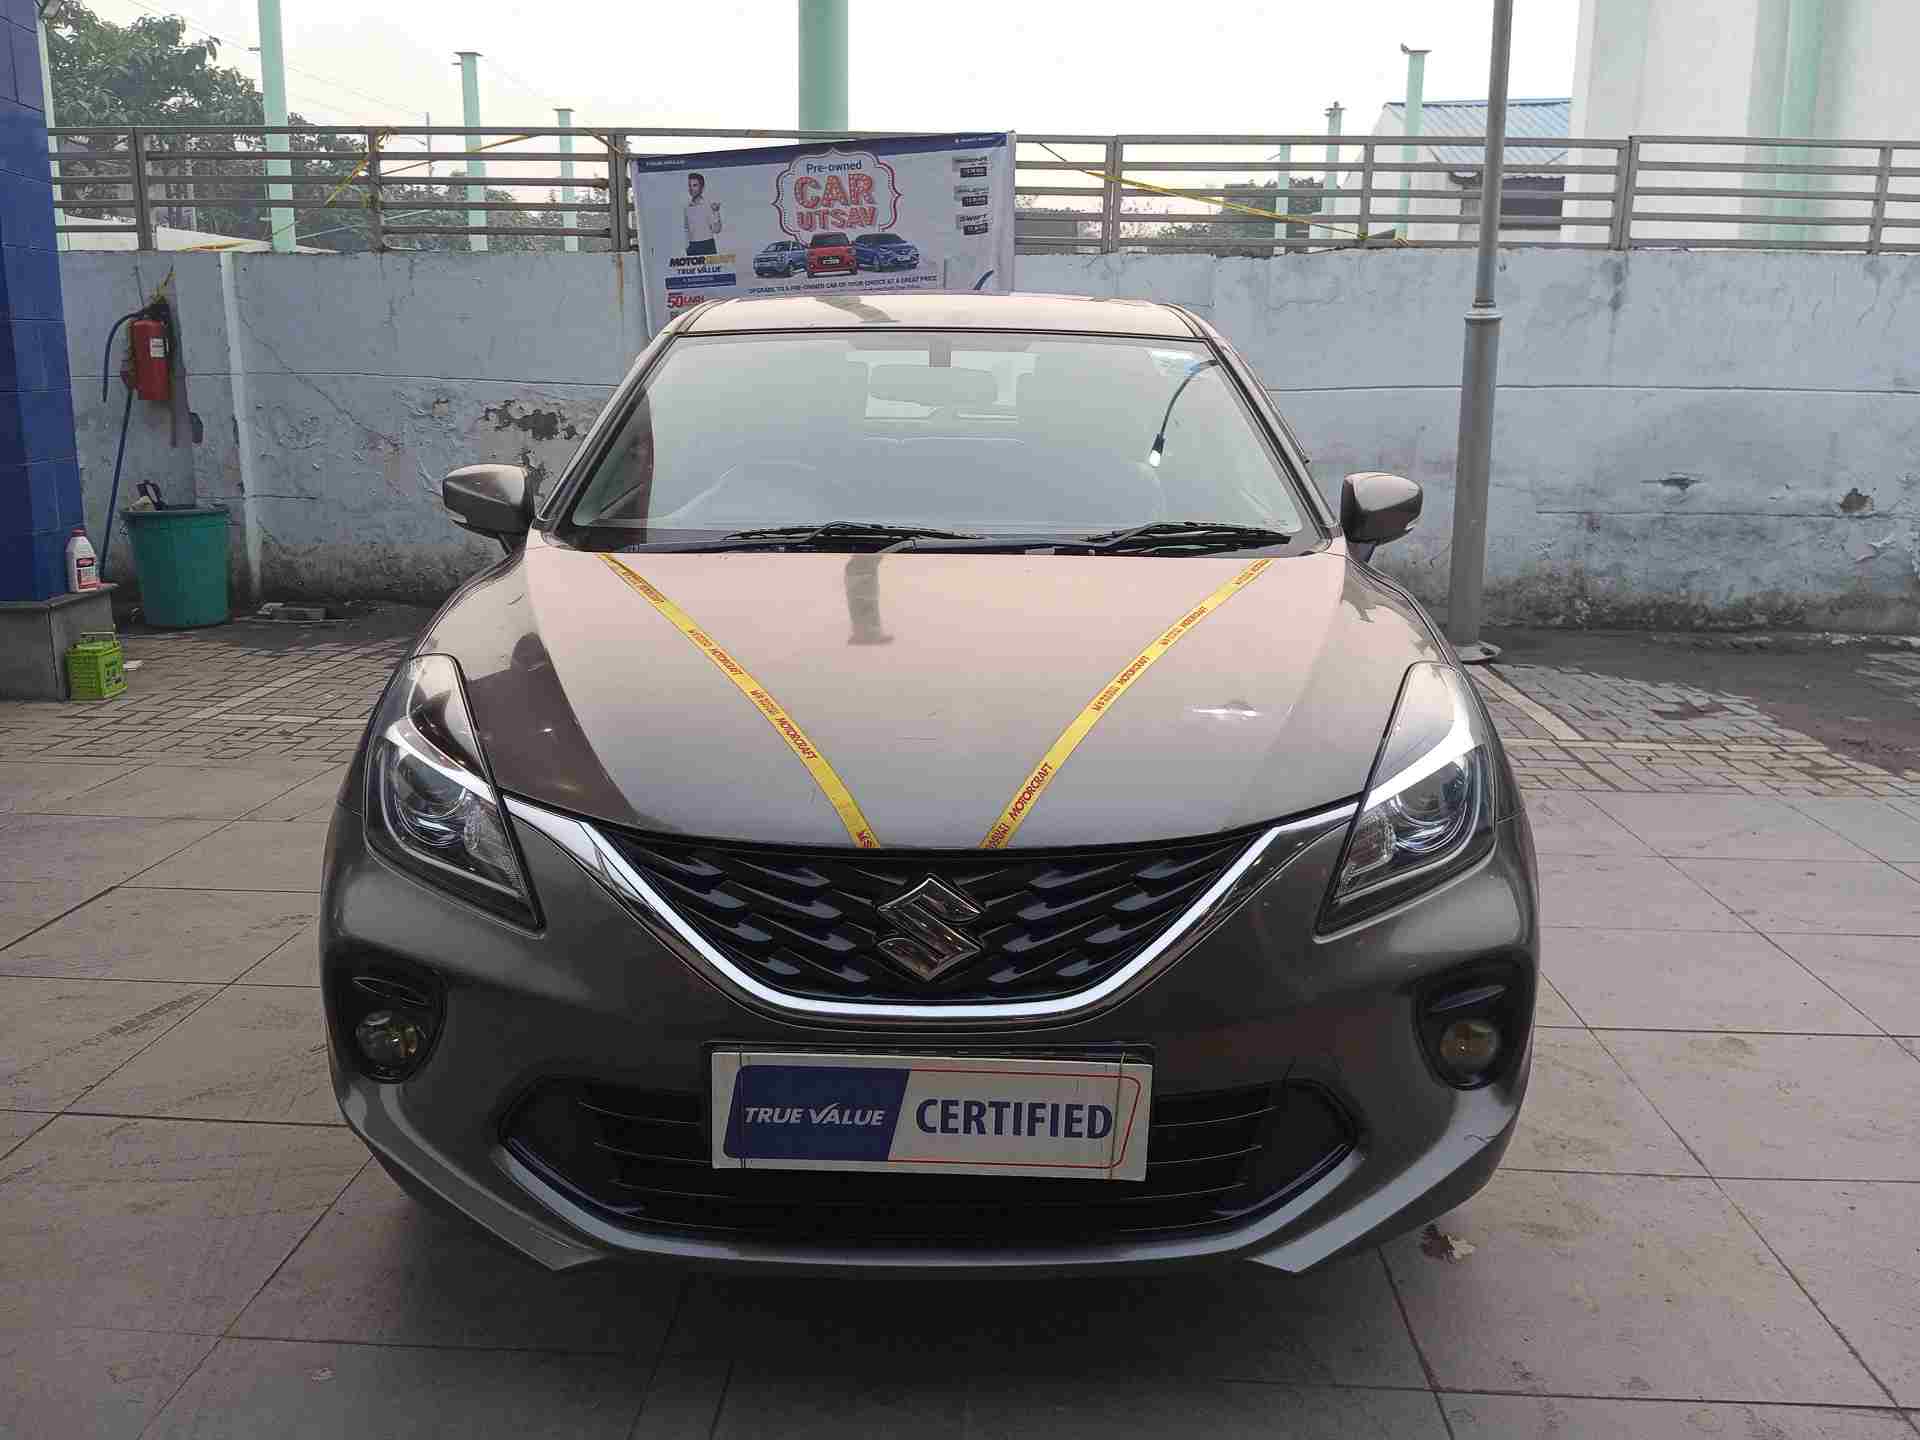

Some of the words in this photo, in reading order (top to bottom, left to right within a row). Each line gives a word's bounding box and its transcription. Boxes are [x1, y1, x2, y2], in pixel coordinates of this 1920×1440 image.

[806, 160, 861, 173] Pre-owned
[794, 174, 877, 208] CAR
[798, 208, 876, 231] UTSAV
[1008, 762, 1052, 821] MOTORCRAFT
[744, 1106, 802, 1125] TRUE
[808, 1102, 885, 1126] VALUE
[915, 1099, 1113, 1139] CERTIFIED
